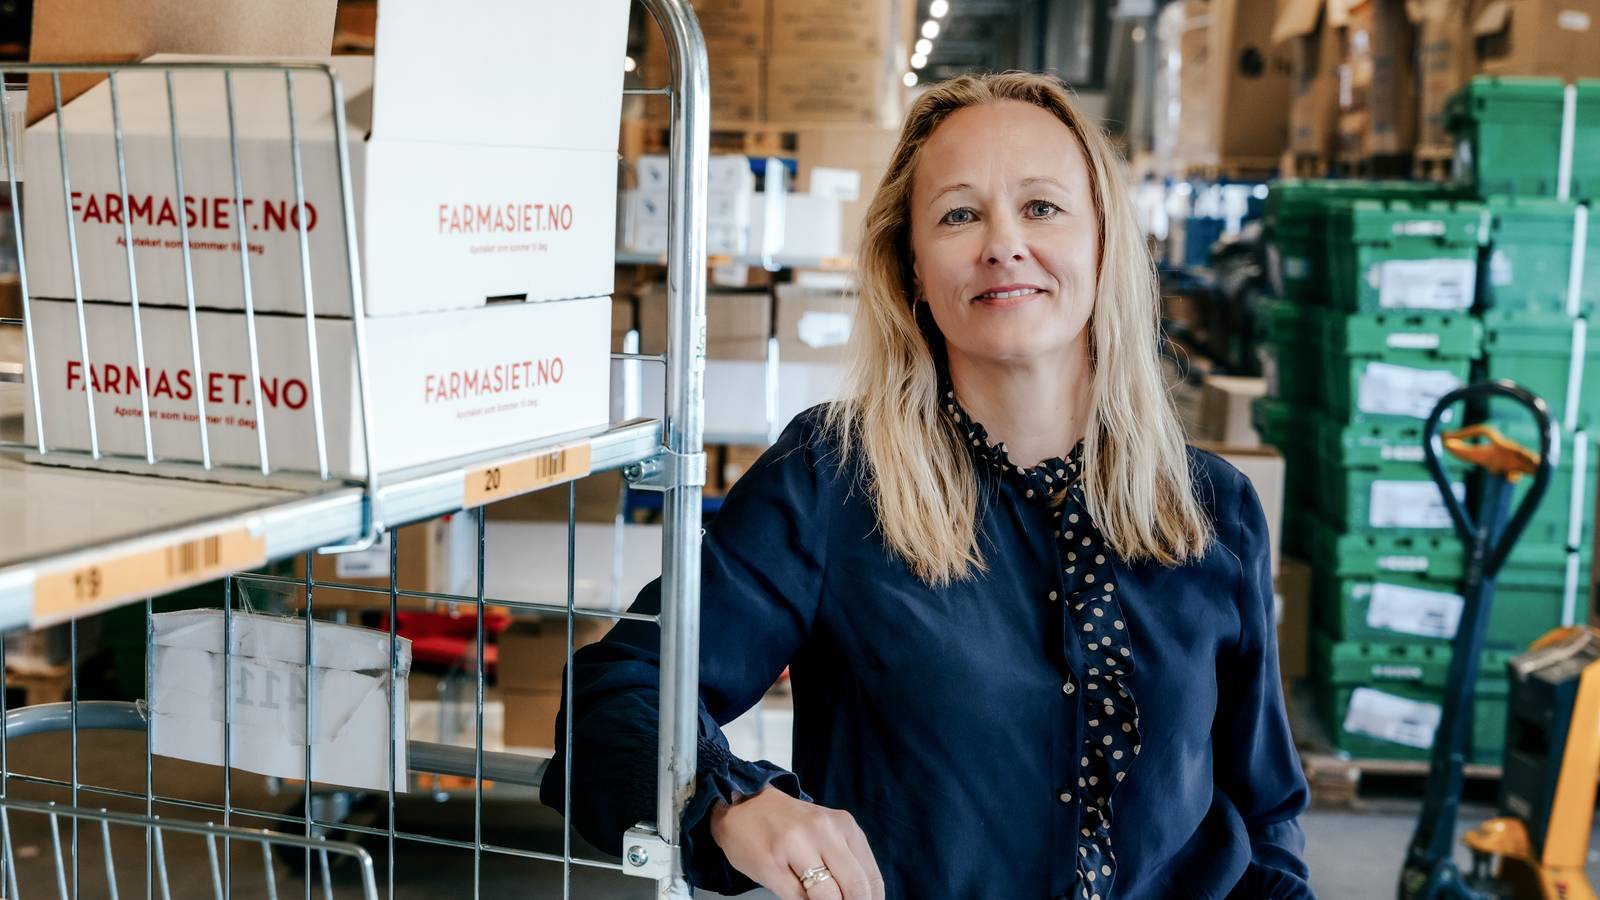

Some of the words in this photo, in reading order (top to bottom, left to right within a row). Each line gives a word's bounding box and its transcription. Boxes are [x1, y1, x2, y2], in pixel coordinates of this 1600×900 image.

[438, 203, 573, 234] FARMASIET.NO
[231, 242, 242, 252] ti
[66, 361, 308, 410] FARMASET.NO
[424, 357, 564, 404] FARMASIET.NO
[114, 406, 158, 418] Apoteet
[485, 467, 501, 492] 20
[72, 567, 102, 599] 19
